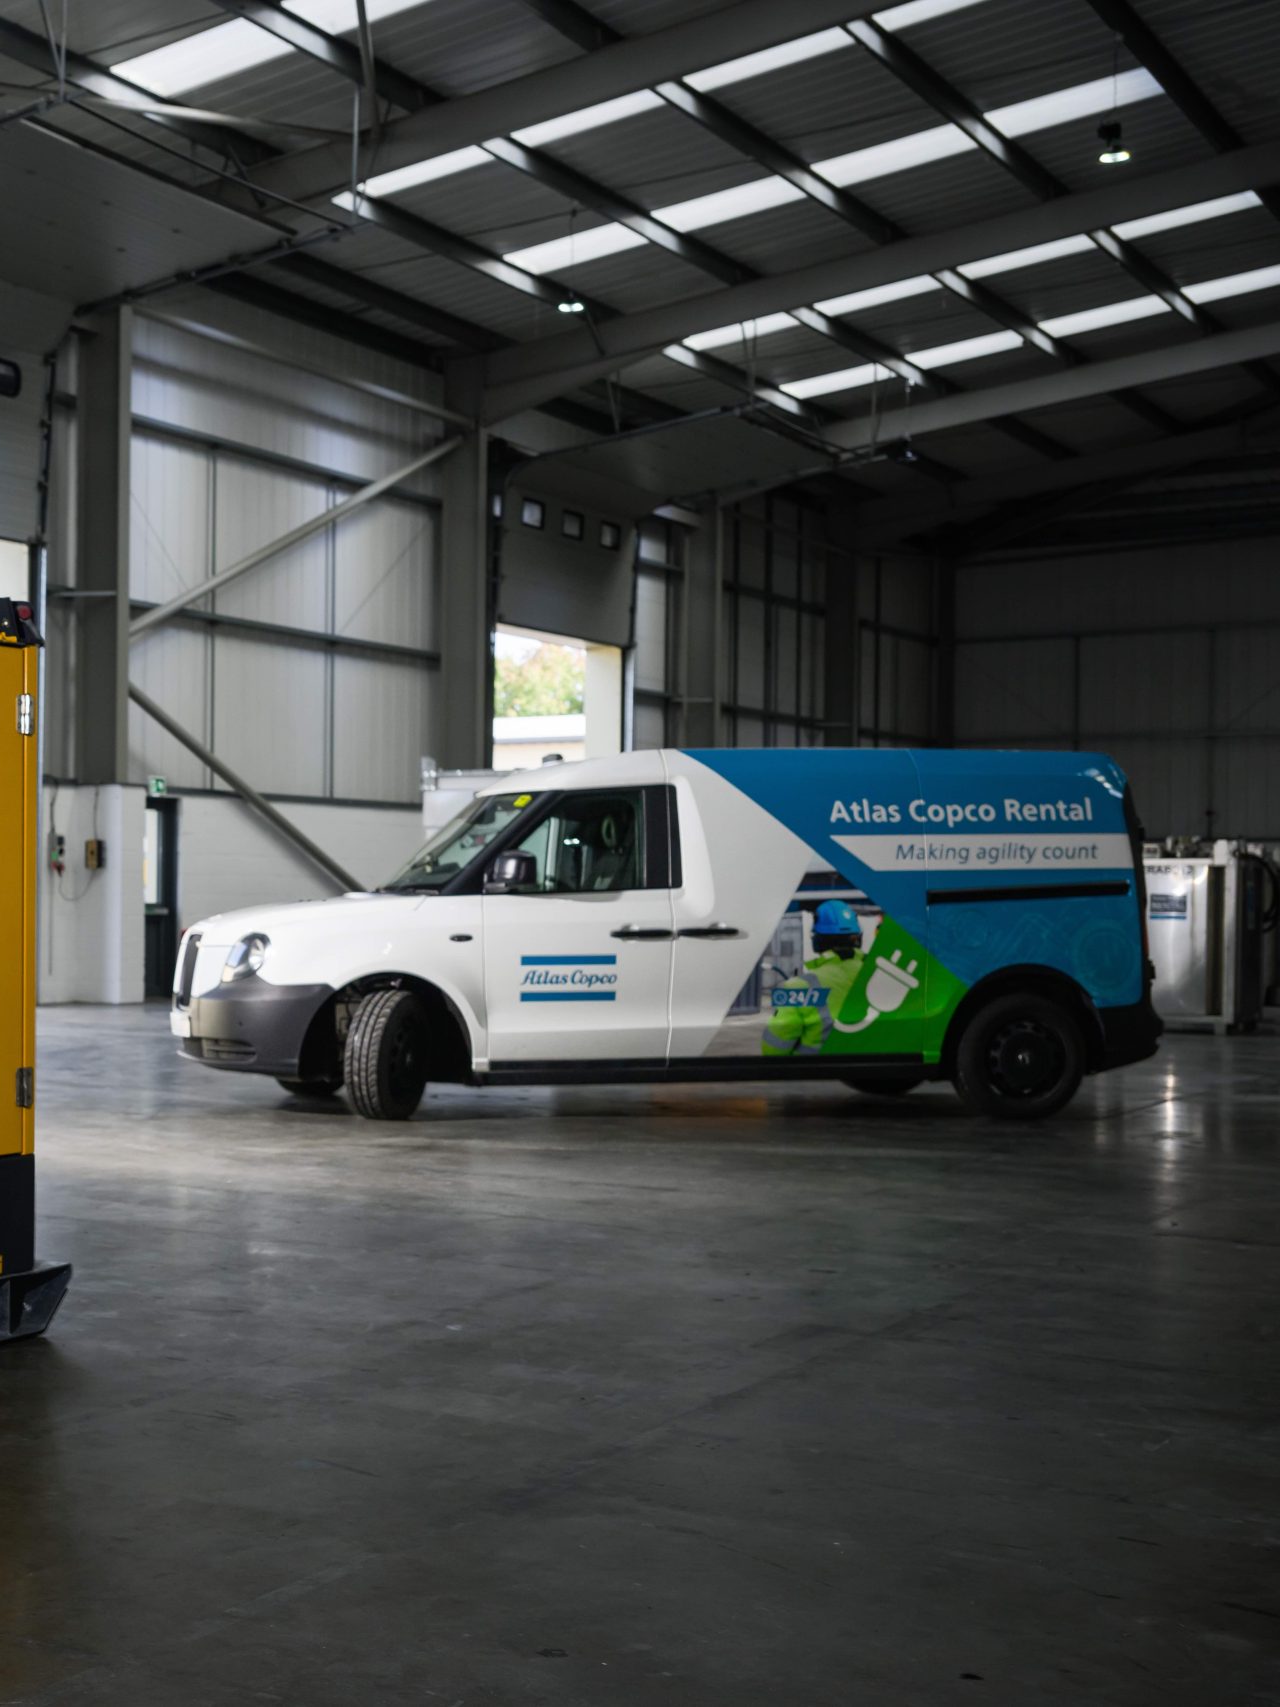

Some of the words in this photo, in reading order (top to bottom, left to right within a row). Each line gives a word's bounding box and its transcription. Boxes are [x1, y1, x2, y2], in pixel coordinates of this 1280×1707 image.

[830, 799, 901, 823] Atlas
[908, 798, 996, 828] Copco
[1004, 797, 1093, 821] Rental
[895, 844, 970, 864] Making
[975, 842, 1037, 864] agility
[1042, 843, 1098, 861] count
[521, 969, 569, 986] Atlas
[570, 969, 618, 989] Copco
[788, 989, 820, 1006] 24/7
